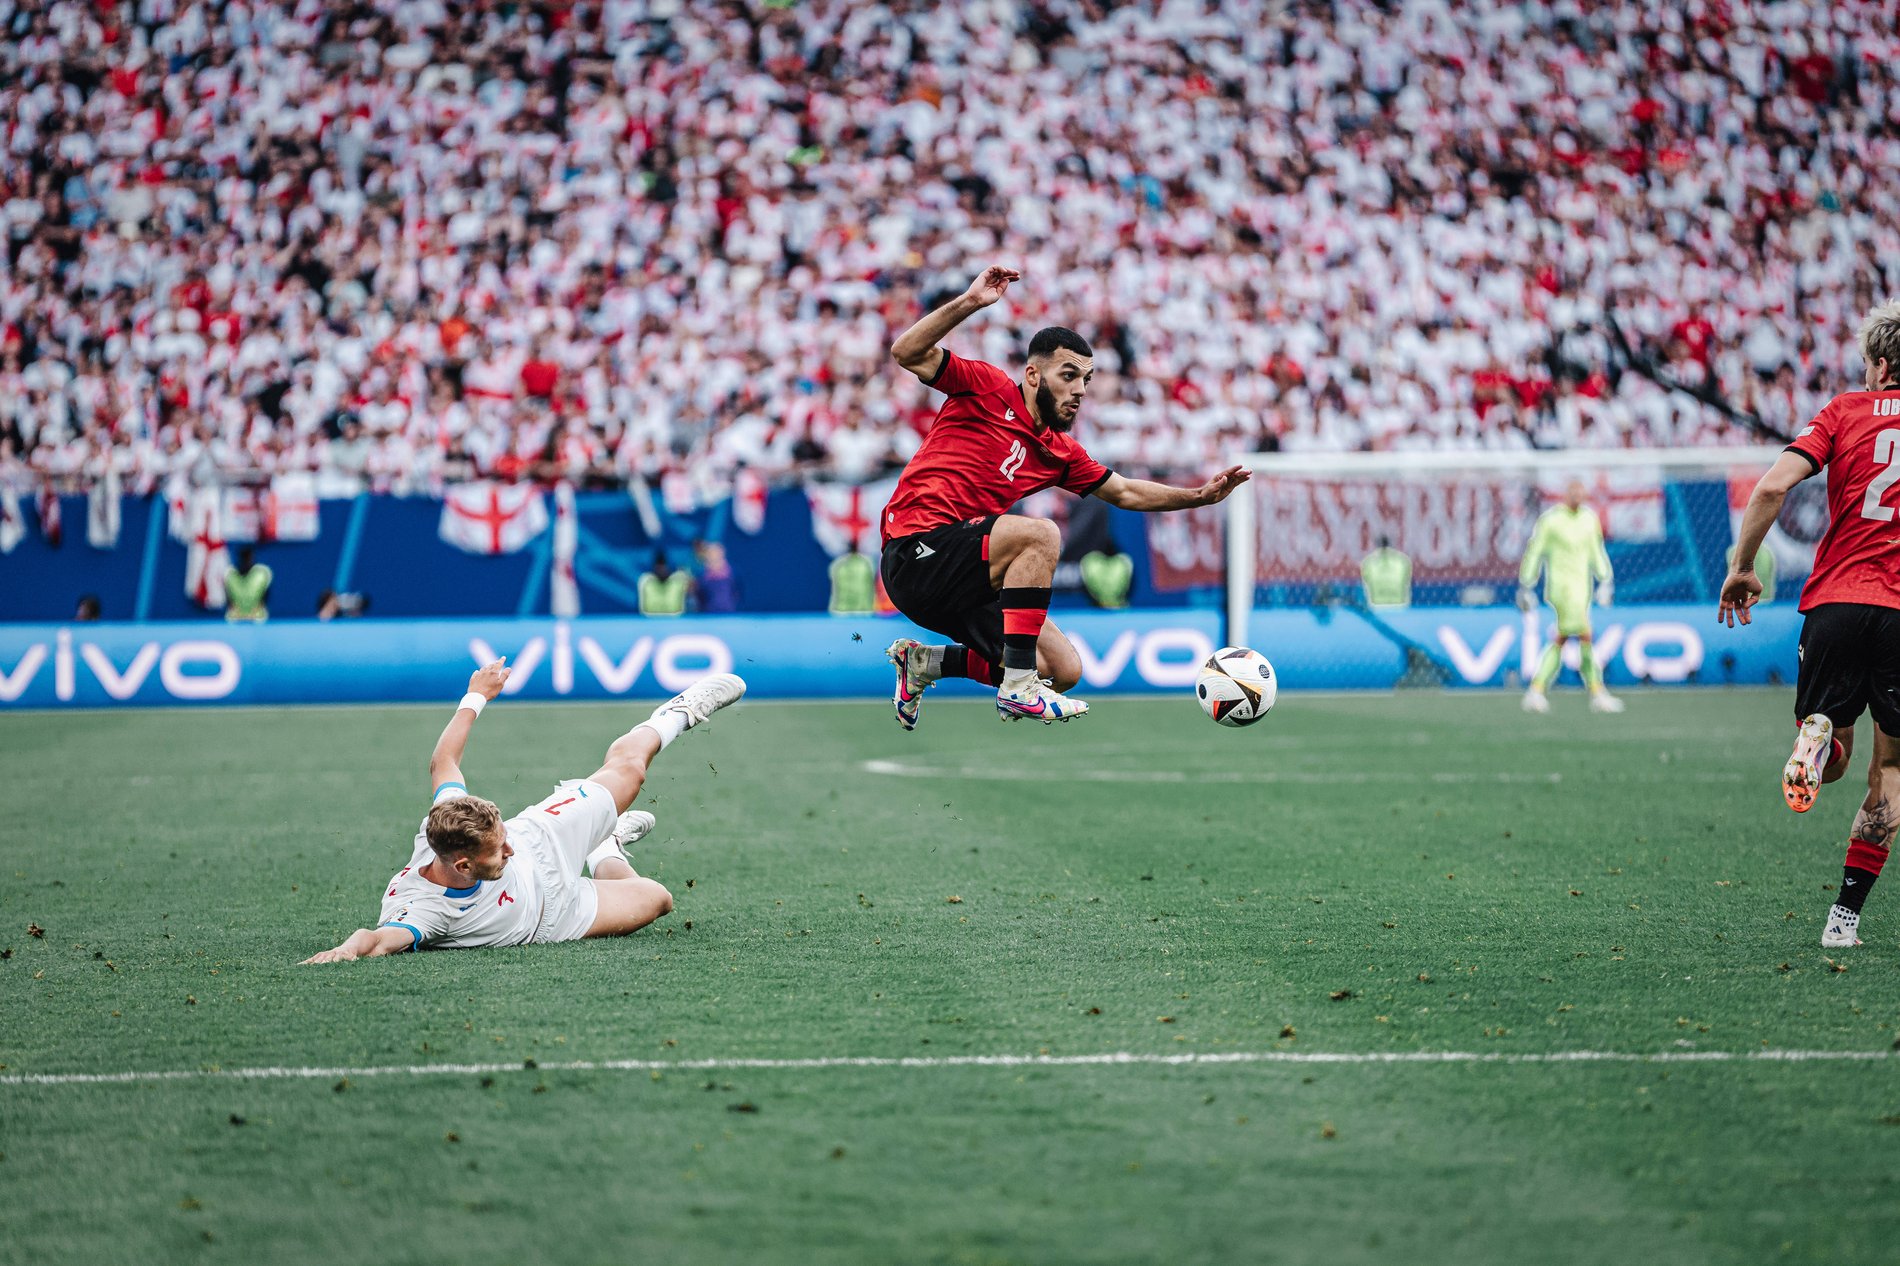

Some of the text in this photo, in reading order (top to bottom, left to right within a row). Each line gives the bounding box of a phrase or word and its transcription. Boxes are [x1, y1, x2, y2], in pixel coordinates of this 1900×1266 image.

[999, 439, 1027, 483] 22
[0, 628, 242, 701] vivo
[468, 620, 735, 695] vivo
[1064, 627, 1217, 689] vo
[543, 797, 576, 815] 7
